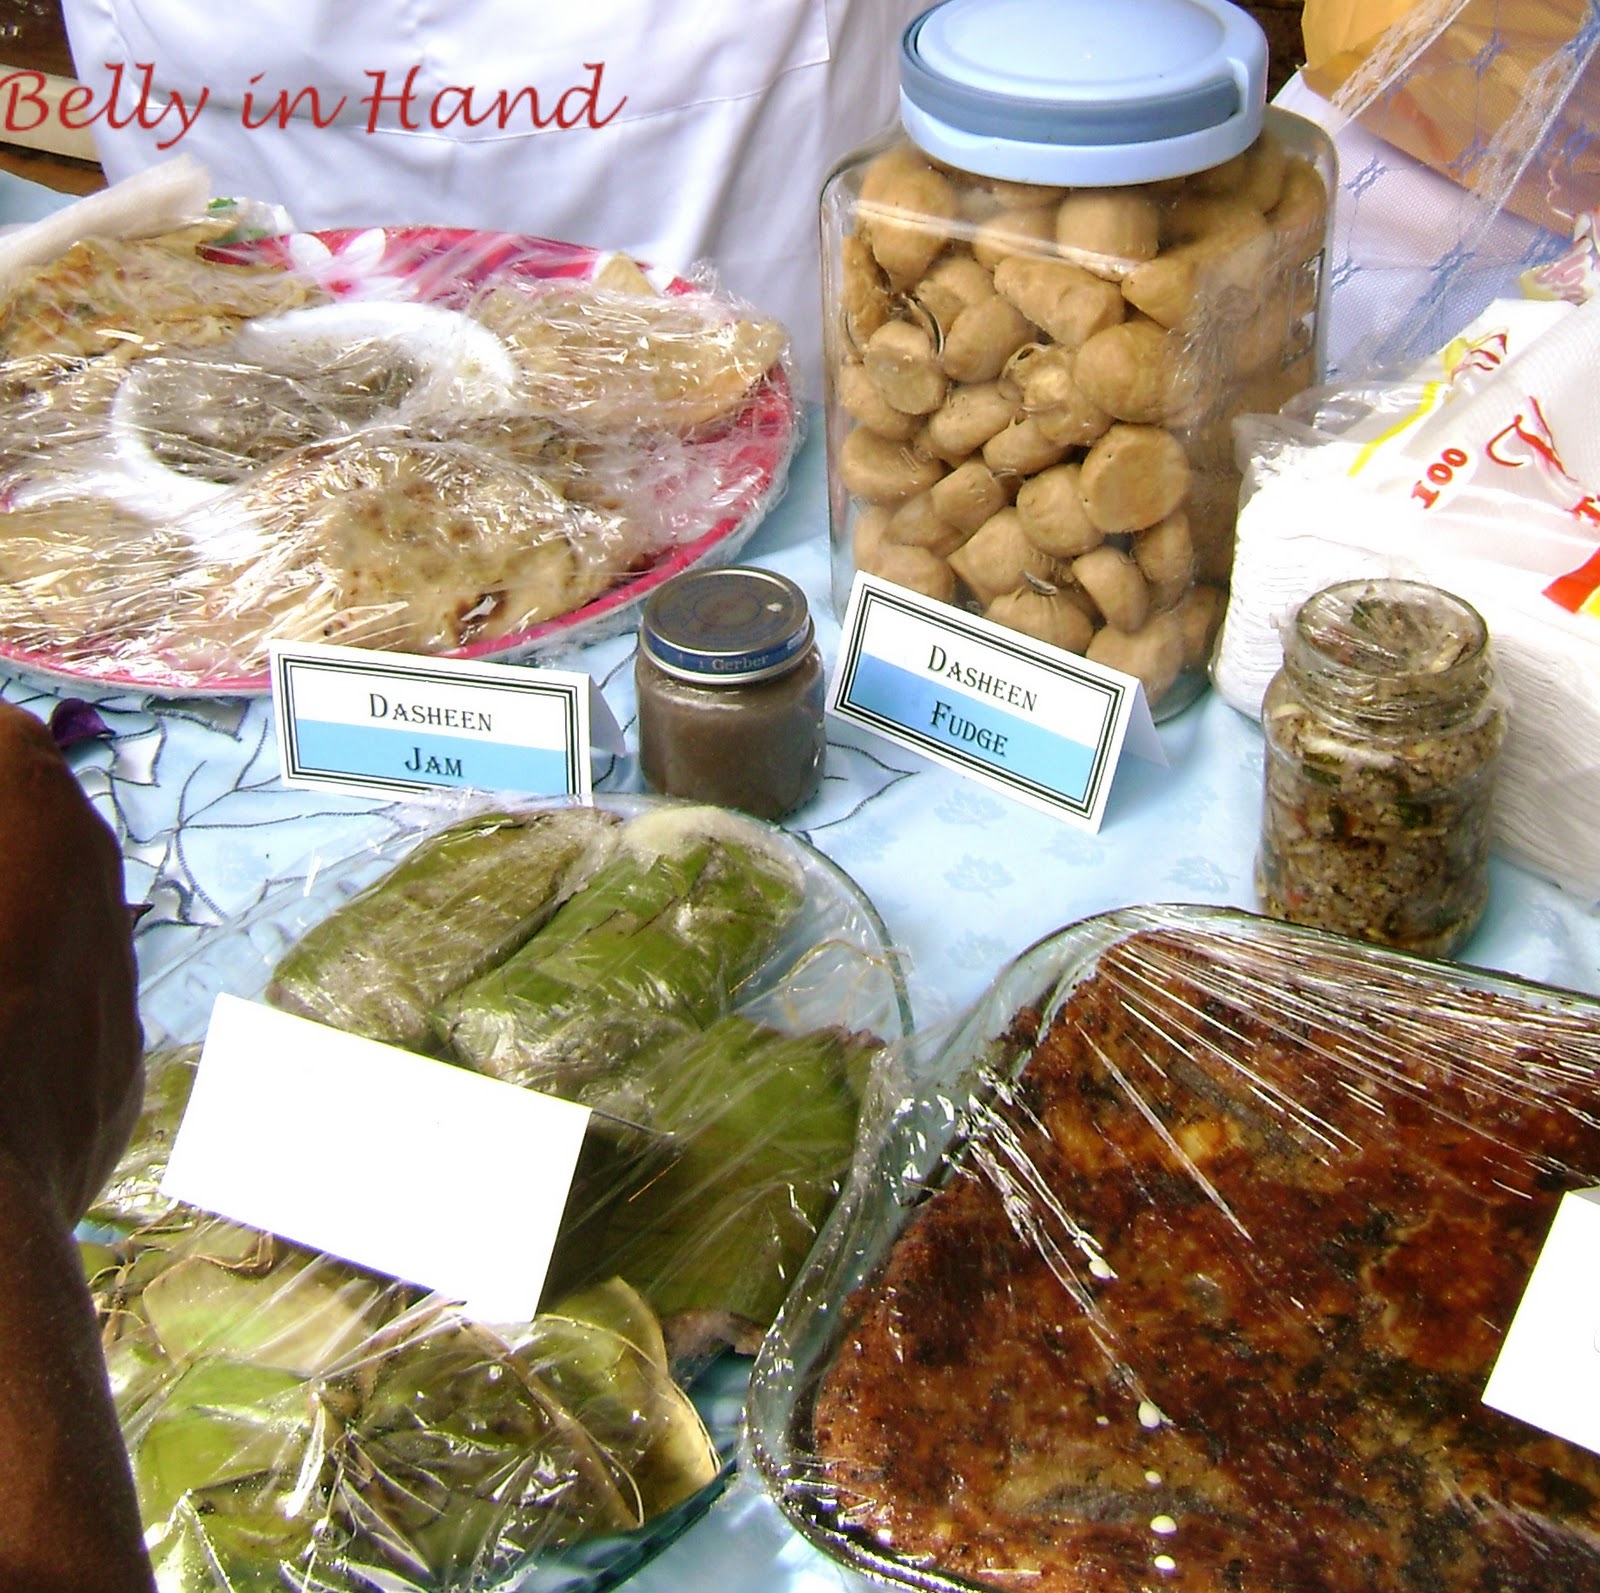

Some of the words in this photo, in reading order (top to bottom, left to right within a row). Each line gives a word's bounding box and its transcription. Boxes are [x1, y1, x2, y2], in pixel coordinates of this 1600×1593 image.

[1411, 447, 1469, 509] 100
[711, 654, 770, 672] Gerber
[928, 644, 1038, 712] DASHEEN
[368, 692, 493, 732] DASHEEN
[930, 700, 1009, 758] FUDGE
[404, 746, 465, 778] JAM
